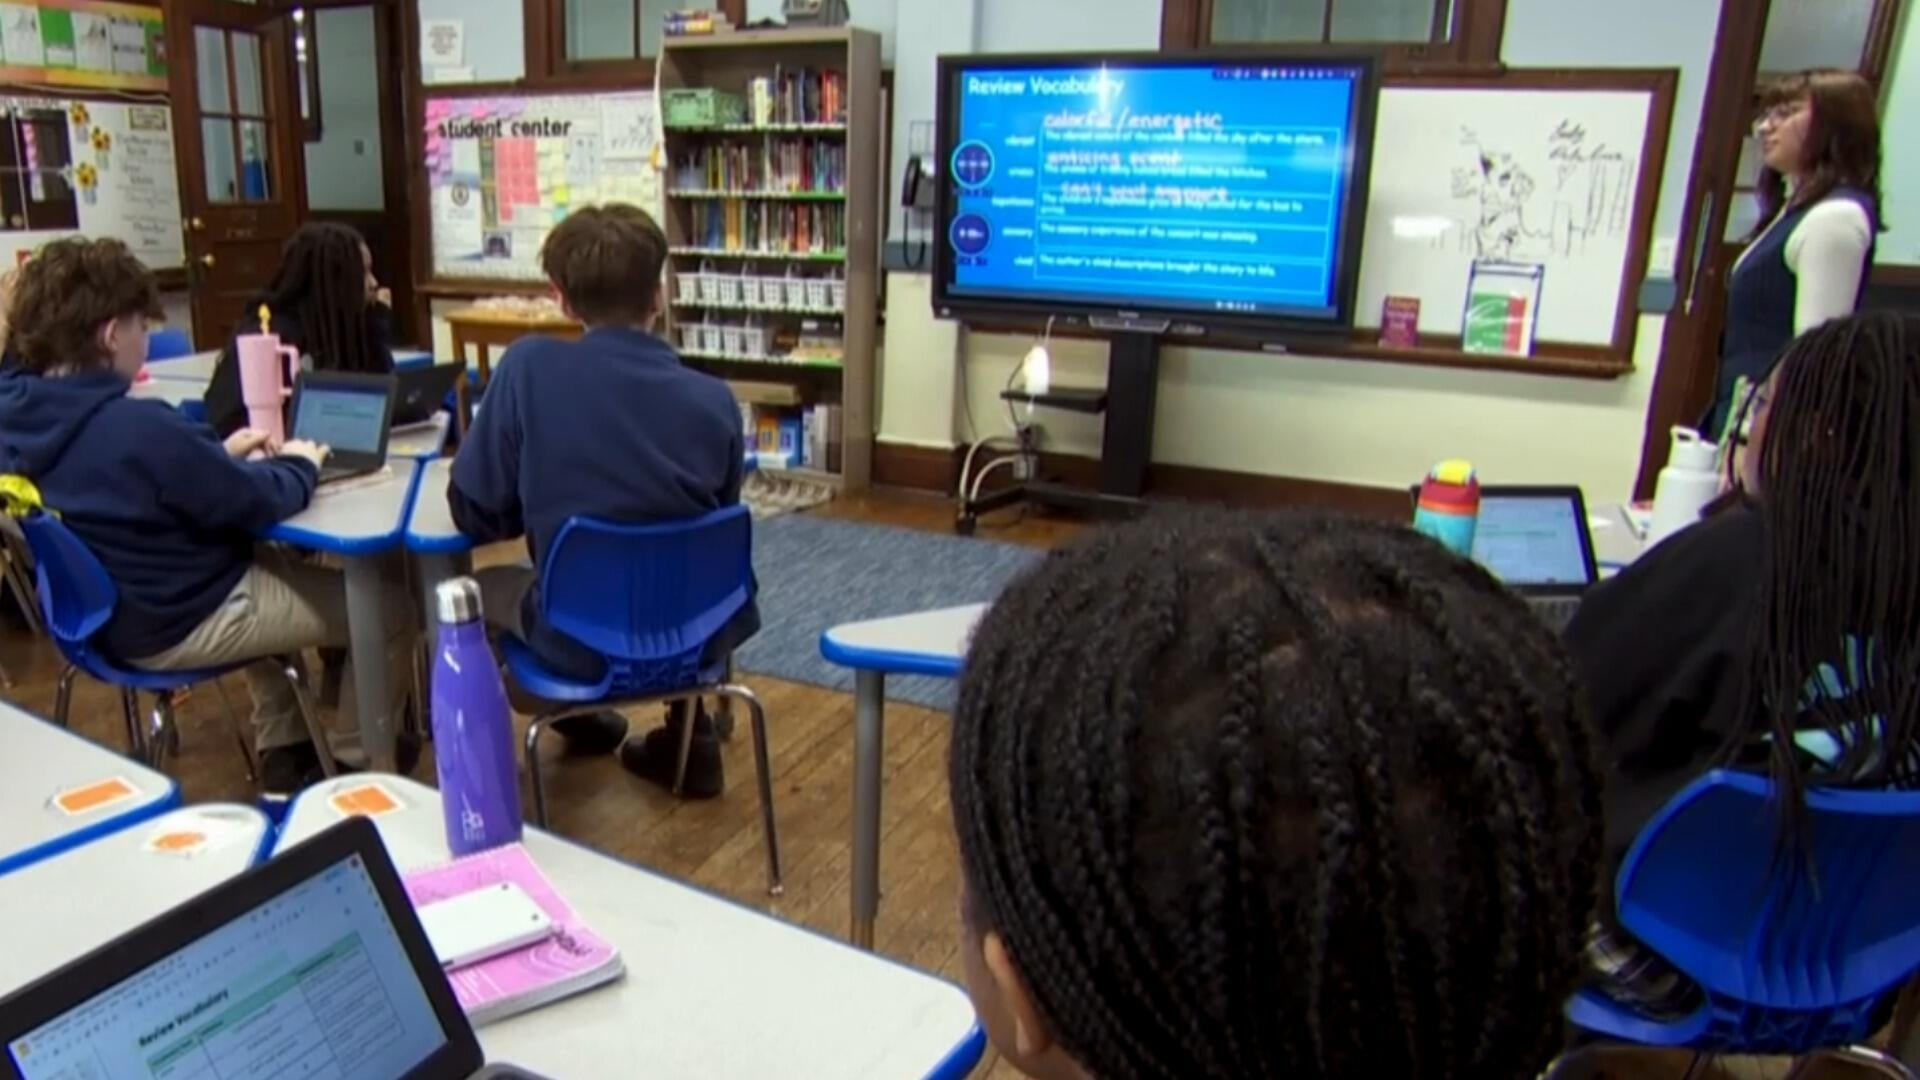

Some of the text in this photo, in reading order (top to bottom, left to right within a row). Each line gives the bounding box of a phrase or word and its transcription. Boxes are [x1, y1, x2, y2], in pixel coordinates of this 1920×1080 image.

[968, 76, 1026, 95] Review
[438, 117, 573, 138] student center
[138, 1017, 176, 1048] Review
[175, 988, 230, 1026] Vocabulary
